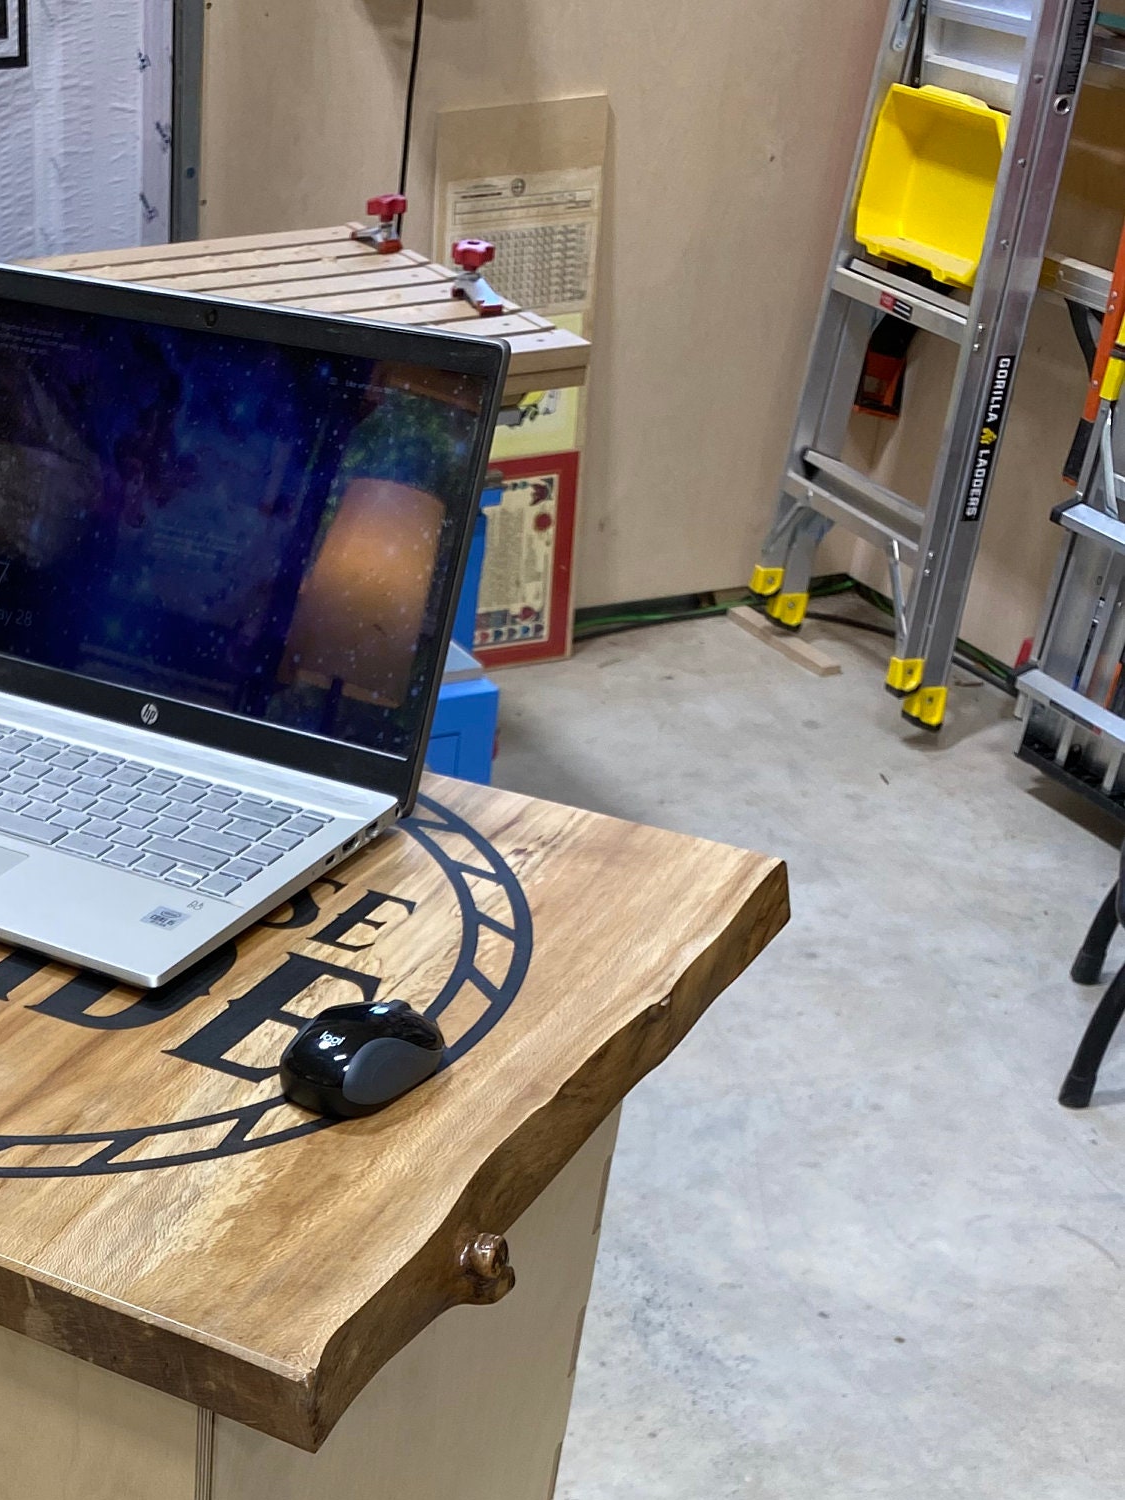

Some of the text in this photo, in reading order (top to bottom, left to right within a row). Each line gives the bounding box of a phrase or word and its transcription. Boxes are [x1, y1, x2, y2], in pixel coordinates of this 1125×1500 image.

[986, 357, 1011, 423] GORILLA
[965, 449, 991, 517] LADDERS
[15, 608, 33, 627] 28
[141, 703, 159, 725] hp
[319, 1029, 348, 1048] logi
